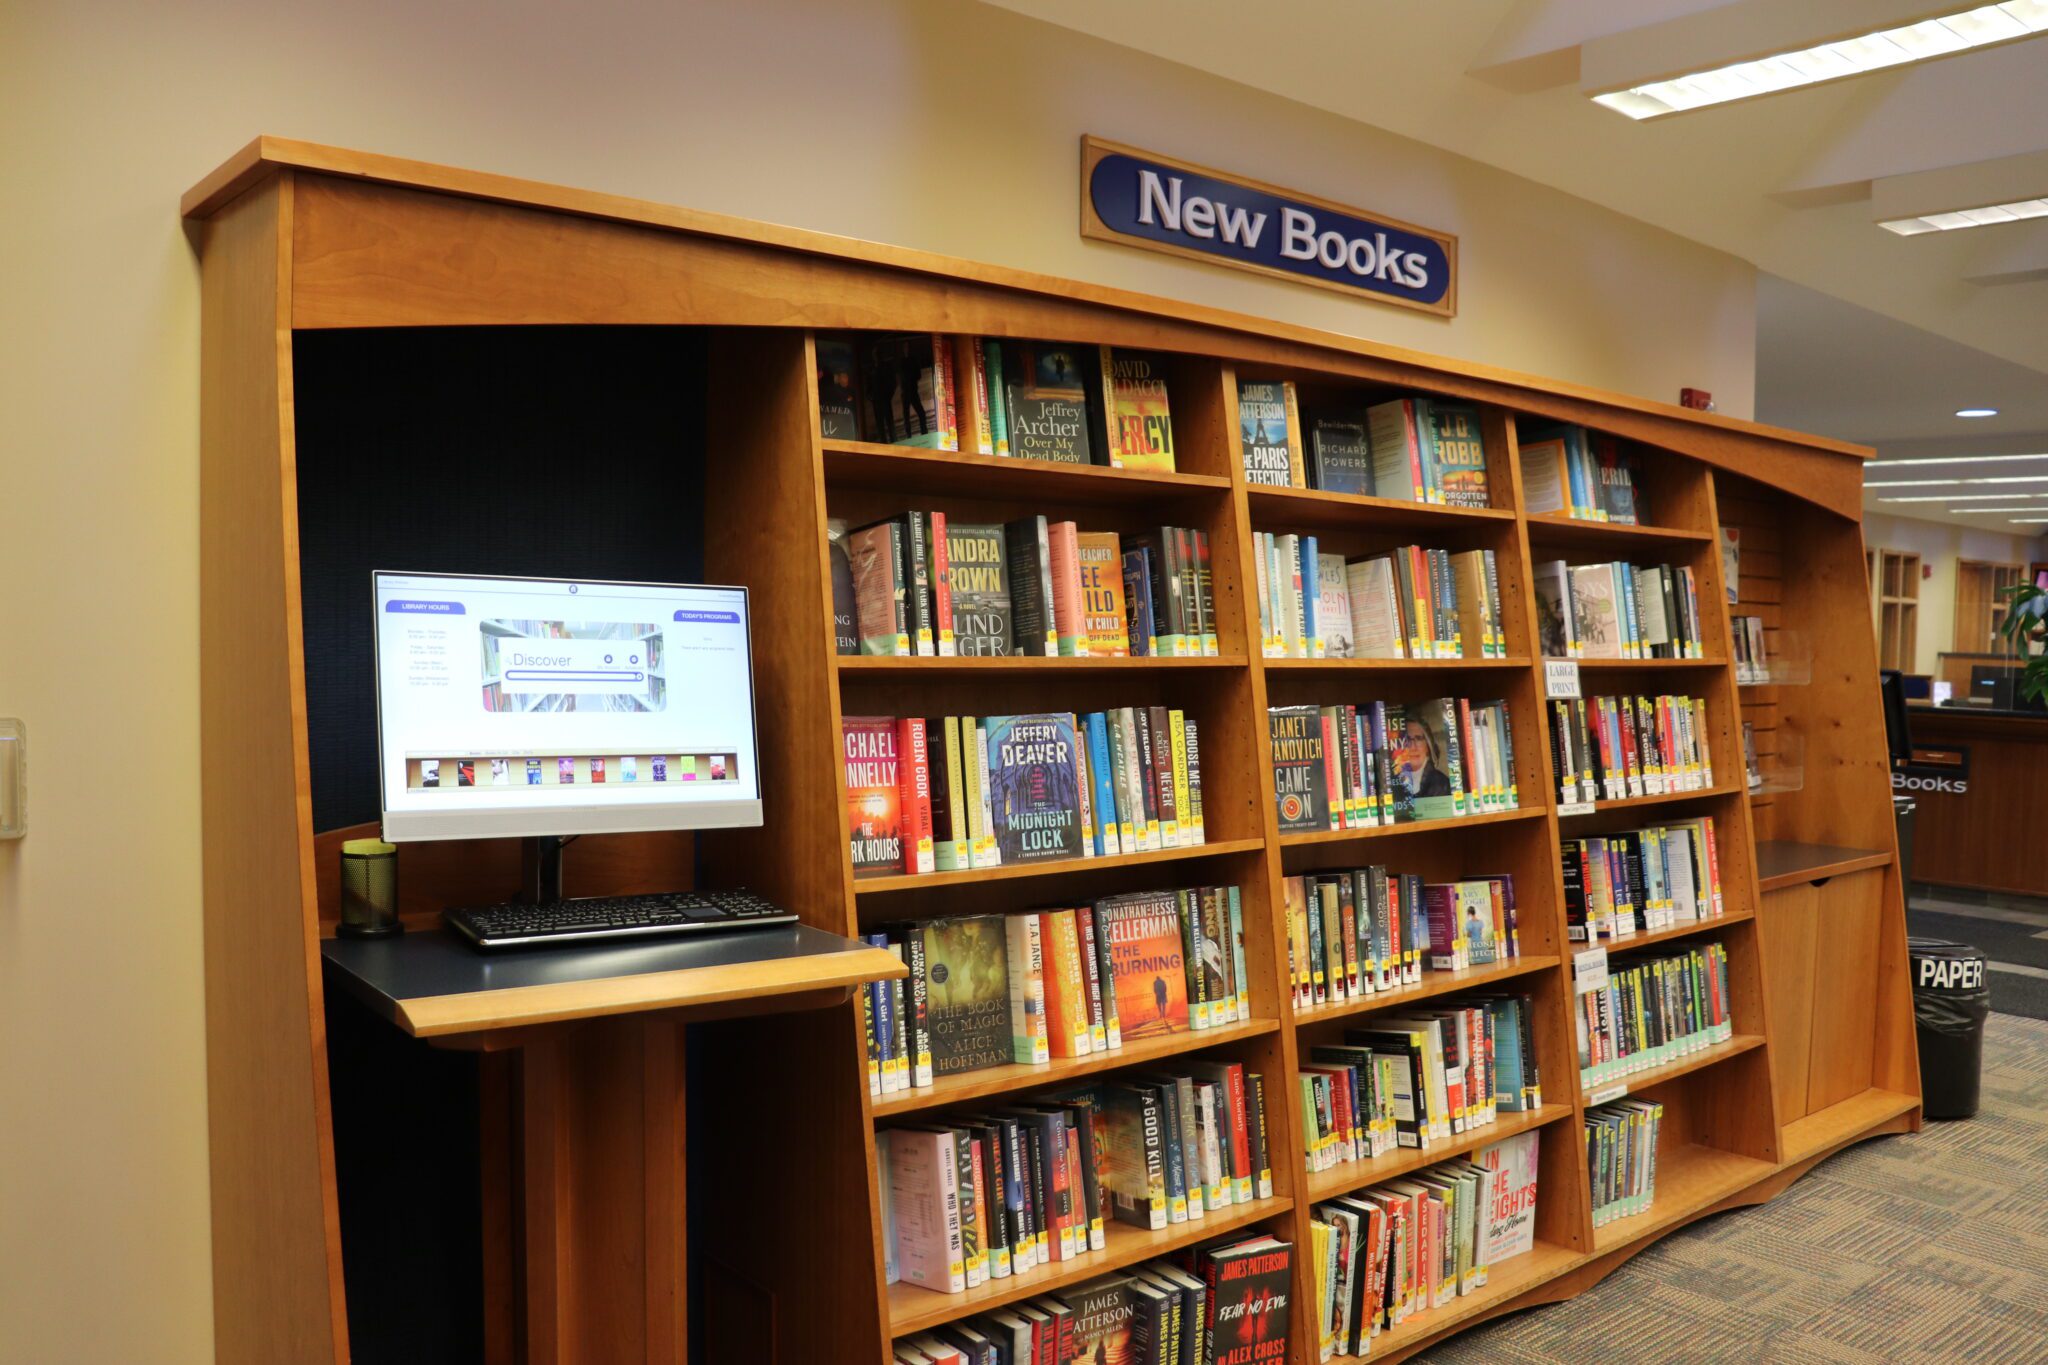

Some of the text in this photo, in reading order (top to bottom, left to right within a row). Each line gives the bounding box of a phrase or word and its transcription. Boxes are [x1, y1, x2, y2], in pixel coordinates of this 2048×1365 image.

[1137, 170, 1428, 290] New Books
[1243, 384, 1273, 401] JAMES
[1038, 402, 1081, 421] Jeffrey
[1240, 402, 1285, 419] ATTERSON
[1014, 416, 1080, 436] Archer
[1118, 415, 1171, 455] ERCY
[1024, 436, 1074, 454] Over My
[1053, 450, 1080, 463] Body
[1320, 444, 1367, 455] RICHARD
[1254, 447, 1289, 470] PARIS
[1324, 457, 1367, 468] POWERS
[1445, 491, 1487, 501] ORGOTTEN
[914, 518, 925, 562] RABBIT HOLE
[1292, 540, 1301, 572] ANIMAL
[950, 568, 1001, 592] ROWN
[919, 588, 928, 607] MARK
[953, 614, 1004, 635] LIND
[1095, 617, 1119, 630] CHILD
[513, 653, 572, 666] Discover
[1550, 665, 1575, 677] LARGE
[1552, 682, 1576, 694] PRINT
[1010, 725, 1057, 742] JEFFERY
[1272, 716, 1306, 738] JANET
[1446, 703, 1458, 744] LOUISE
[846, 733, 896, 758] CHAEL
[1140, 712, 1152, 765] JOY FIELDING
[1155, 730, 1166, 766] FOLLETT
[1270, 738, 1322, 761] ANOVICH
[1002, 742, 1067, 767] DEAVER
[1174, 714, 1187, 790] LISA GARDNER
[1185, 725, 1201, 786] CHOOSE ME
[846, 762, 896, 788] NNELLY
[911, 723, 929, 831] ROBIN COOK VIRAL
[1116, 744, 1127, 788] WEATHER
[1160, 771, 1173, 807] NEVER
[1275, 766, 1312, 793] GAME
[1890, 772, 1968, 794] Books
[861, 822, 873, 836] THE
[1022, 830, 1063, 851] LOCK
[867, 837, 900, 862] HOURS
[1151, 901, 1176, 916] JESSE
[1203, 896, 1218, 938] KING
[1221, 898, 1229, 923] DEAN
[1030, 922, 1042, 975] J.A. JANCE
[1114, 946, 1141, 958] THE
[1189, 893, 1205, 987] JONATHAN KELLERMAN CITY
[911, 940, 922, 1007] SUPPORT GROUP
[1085, 925, 1101, 1000] IRIS JOHANSEN HIGH
[1113, 954, 1181, 977] BURNING
[1919, 959, 1983, 989] PAPER
[879, 980, 888, 1022] Black Girl
[919, 981, 927, 1000] GIRL
[936, 998, 1005, 1019] THE BOOK
[863, 996, 875, 1047] WALLS
[898, 1020, 907, 1048] PETER
[937, 1013, 1006, 1034] OF MAGIC
[954, 1035, 993, 1052] ALICE
[940, 1048, 1008, 1070] HOFFMAN
[1233, 1073, 1244, 1132] Liane Moriarty
[1010, 1125, 1018, 1136] ERIC
[1055, 1120, 1065, 1148] Count
[1142, 1096, 1161, 1181] A GOOD KILL
[1485, 1148, 1500, 1169] IN
[972, 1154, 984, 1206] Songbirds
[1059, 1164, 1067, 1187] Ways
[946, 1192, 961, 1251] WHO THEY WAS
[1421, 1201, 1429, 1287] SEDARIS
[1221, 1251, 1289, 1281] JAMES PATTERSON
[1366, 1252, 1376, 1293] MILK STREET
[1377, 1229, 1391, 1308] BEAT BOBBY FLAY
[1084, 1291, 1119, 1318] JAMES
[1195, 1302, 1205, 1330] JAMES
[1219, 1294, 1288, 1321] FEAR NO EVIL
[1072, 1304, 1134, 1334] ATTERSON
[1105, 1324, 1124, 1336] ALLEN
[1160, 1312, 1169, 1340] JAMES
[1171, 1305, 1181, 1333] JAMES
[1228, 1338, 1285, 1364] ALEX CROSS
